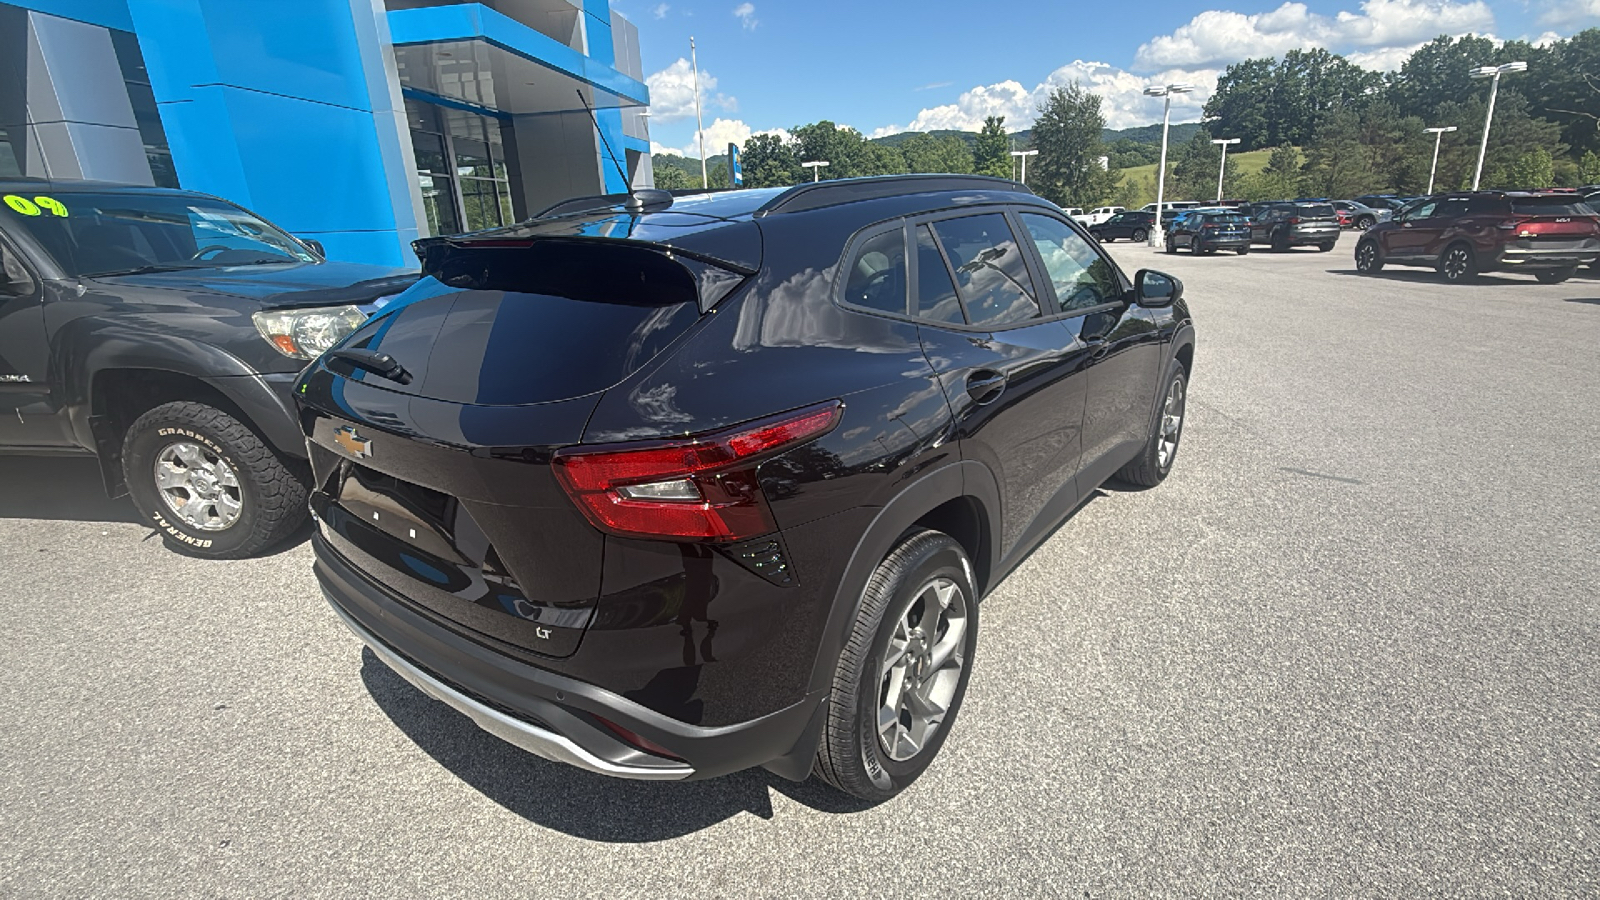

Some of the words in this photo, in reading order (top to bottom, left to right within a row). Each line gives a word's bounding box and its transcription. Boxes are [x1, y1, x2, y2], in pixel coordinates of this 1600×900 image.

[3, 195, 69, 217] 09
[158, 427, 222, 454] GRABBER
[153, 511, 213, 548] GENERAL
[536, 626, 553, 640] LT
